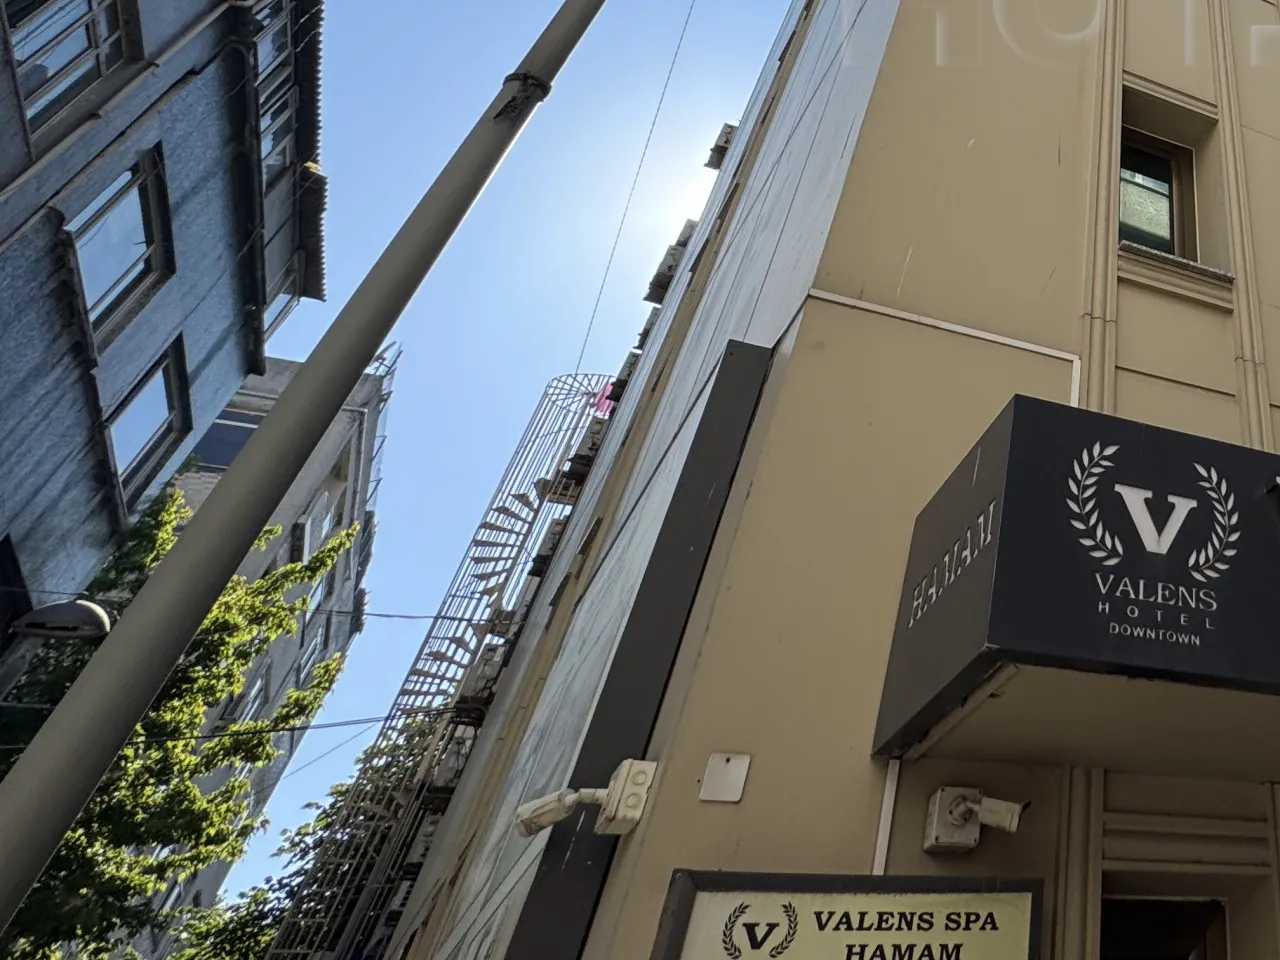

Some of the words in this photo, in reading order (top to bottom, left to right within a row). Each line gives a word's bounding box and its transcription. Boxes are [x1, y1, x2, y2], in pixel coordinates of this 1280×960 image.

[1113, 483, 1198, 555] V
[907, 499, 996, 629] HAMAM
[1094, 572, 1218, 612] VALENS
[1098, 601, 1216, 630] HOTEL
[1109, 622, 1200, 646] DOWNTOWN
[812, 911, 935, 932] VALENS
[944, 911, 1000, 932] SPA
[742, 922, 780, 951] V
[844, 943, 965, 960] HAMAM
